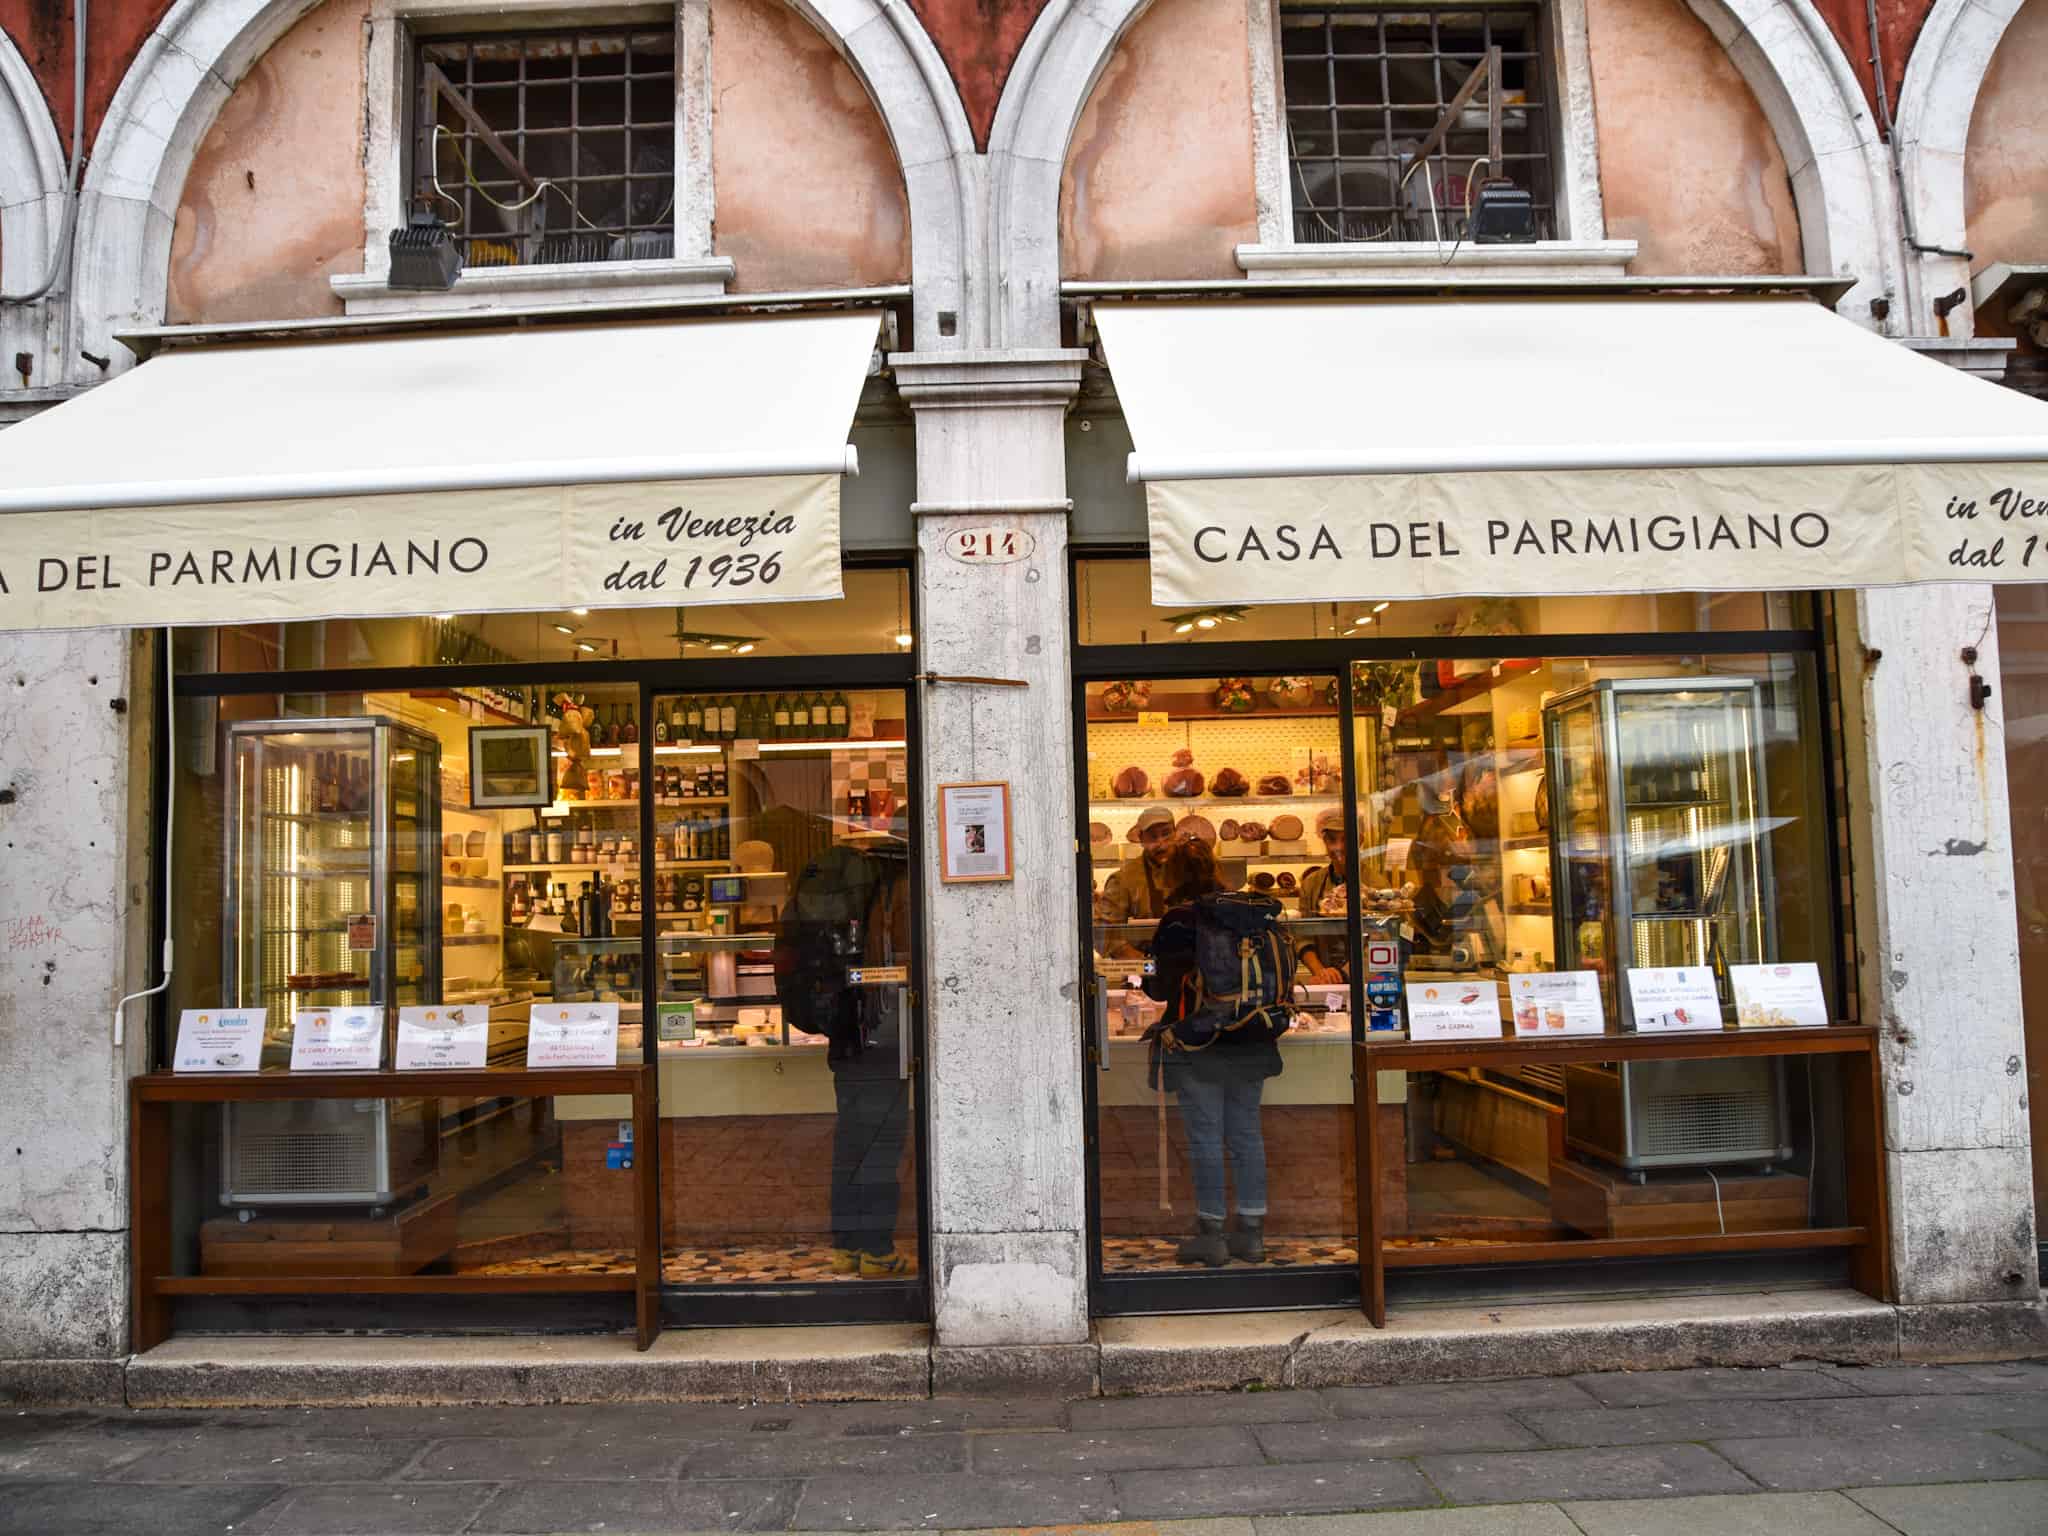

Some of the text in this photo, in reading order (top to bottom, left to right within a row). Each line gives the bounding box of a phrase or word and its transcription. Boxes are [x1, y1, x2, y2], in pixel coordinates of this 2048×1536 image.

[609, 506, 794, 548] in Venezia
[1946, 495, 1979, 520] in
[960, 533, 1016, 556] 214
[1193, 512, 1829, 563] CASA DEL PARMIGIANO
[1948, 535, 2048, 568] dal 1
[38, 554, 121, 593] DEL
[149, 537, 488, 587] PARMIGIANO
[603, 551, 782, 591] dal 1936
